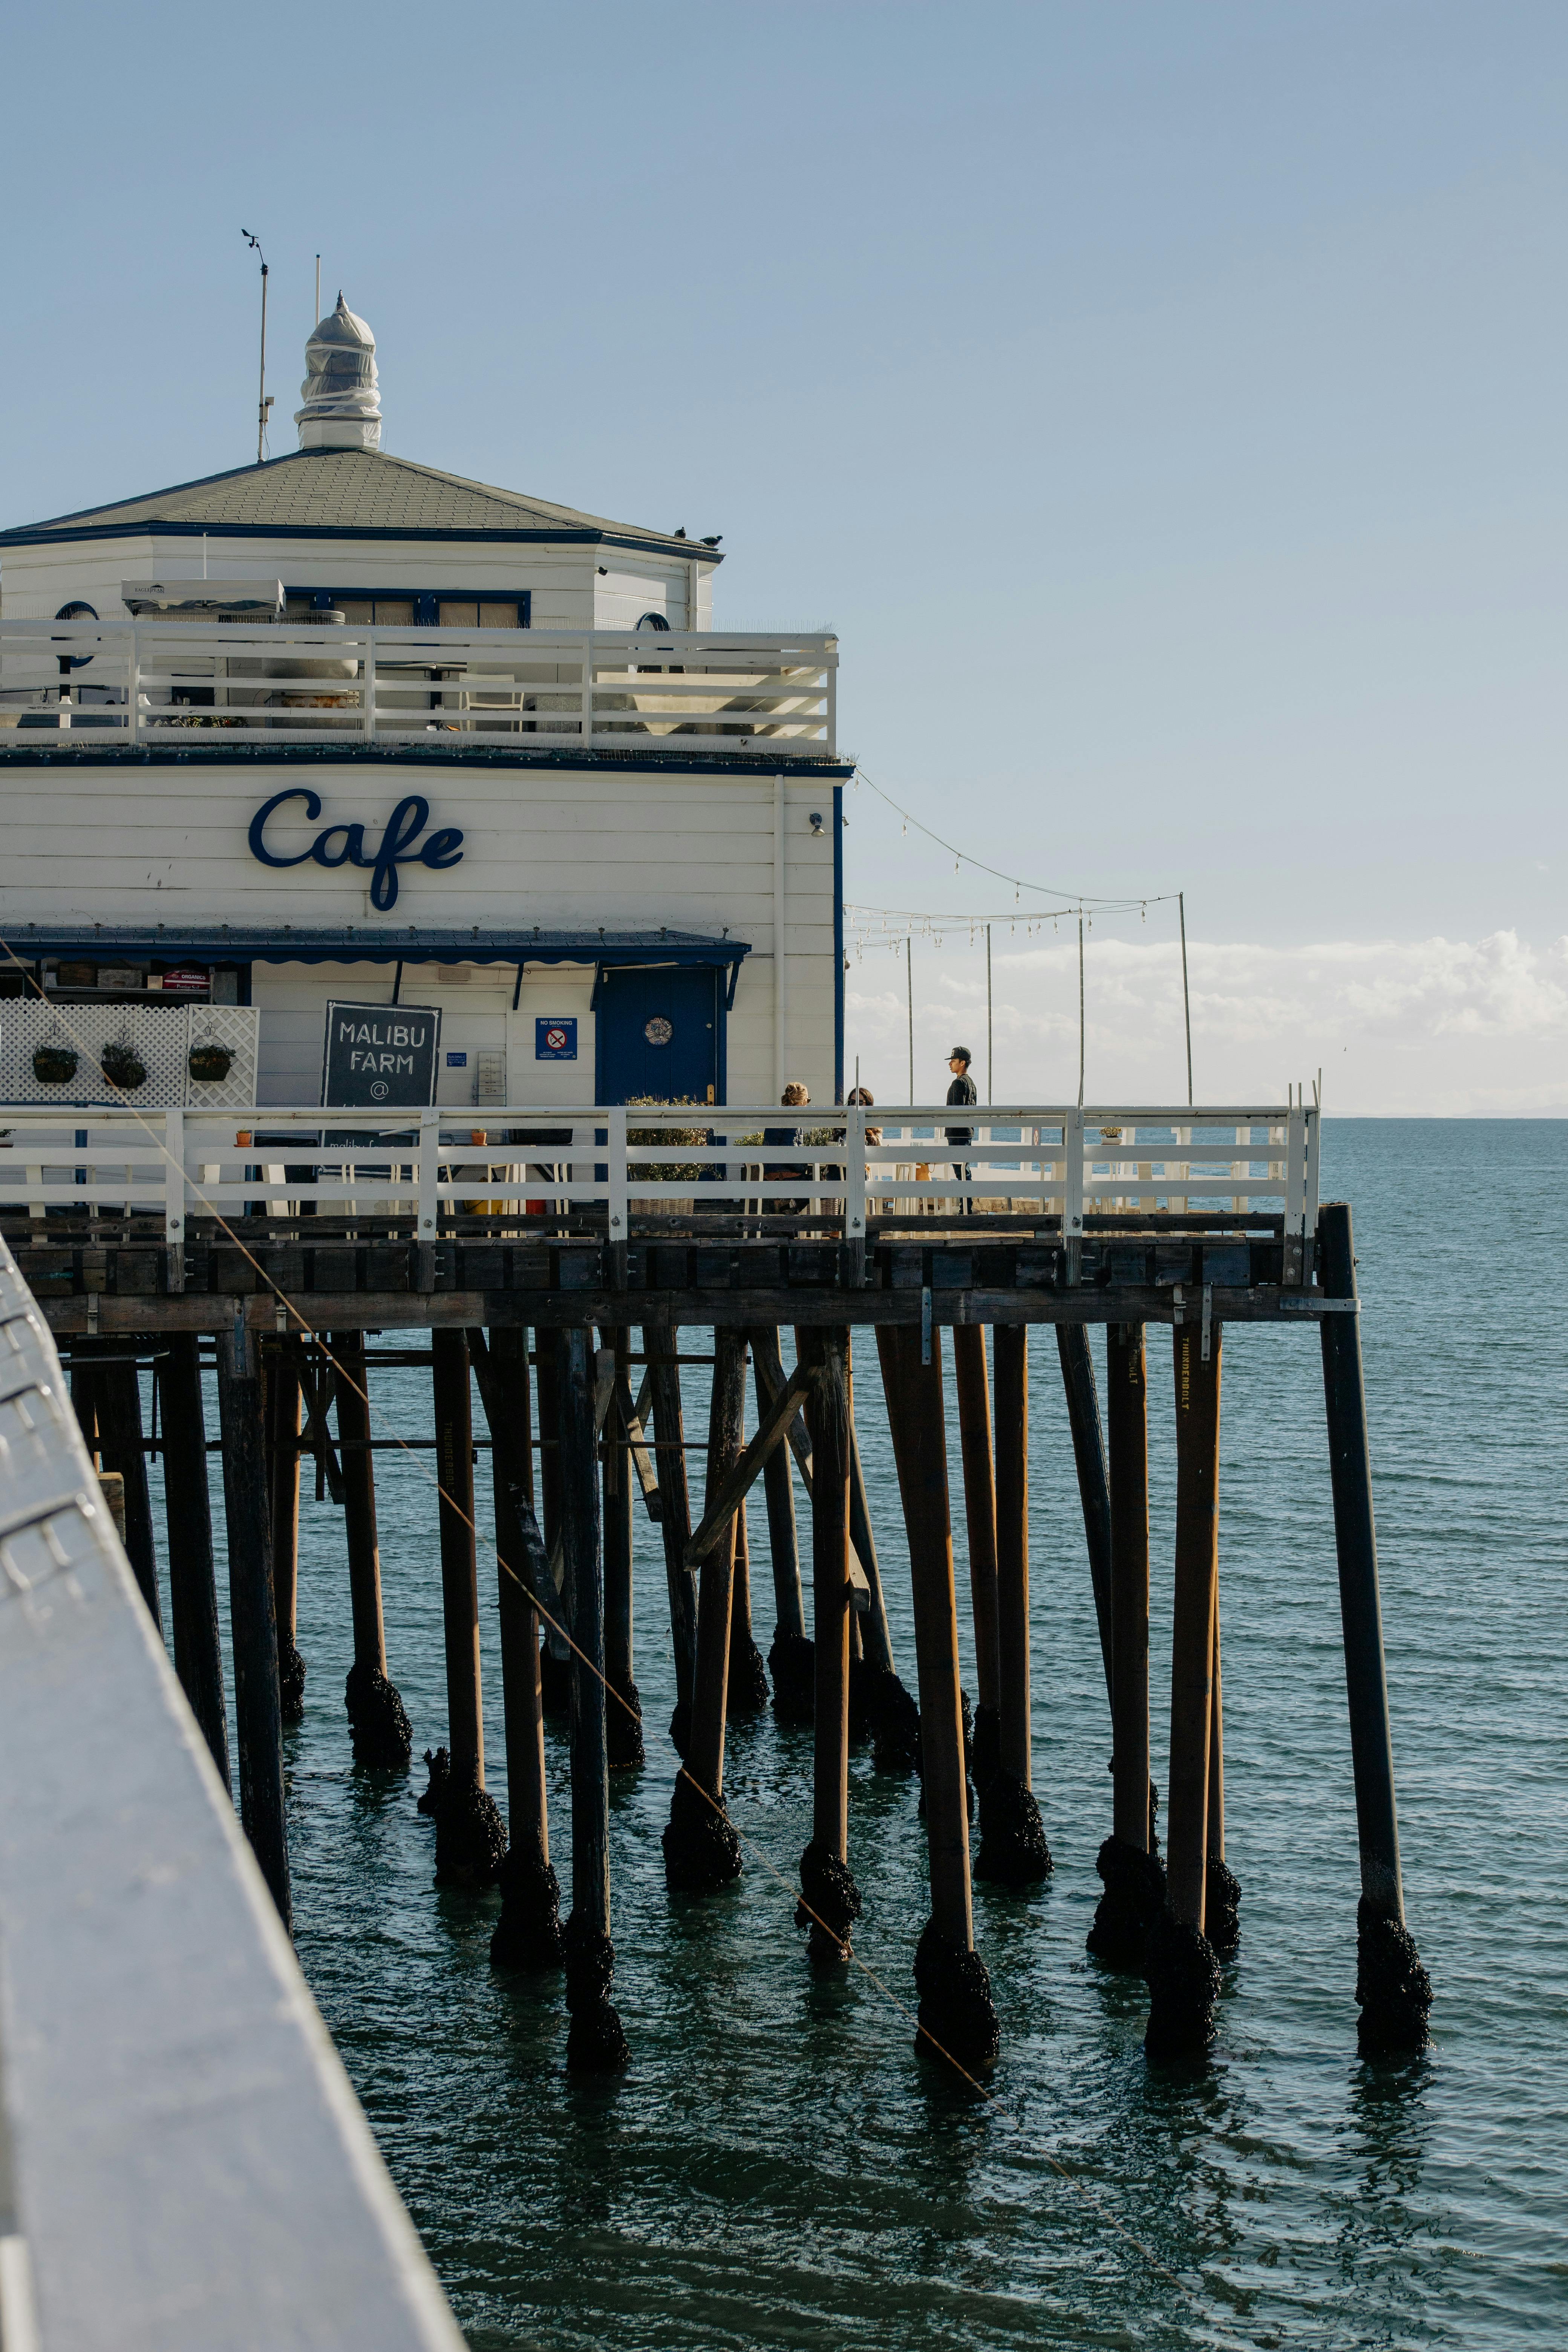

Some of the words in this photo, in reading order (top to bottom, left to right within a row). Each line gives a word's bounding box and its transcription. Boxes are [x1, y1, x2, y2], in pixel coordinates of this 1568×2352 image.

[248, 788, 464, 911] Cafe
[340, 1022, 425, 1047] MALIBU
[351, 1051, 413, 1075] FARM
